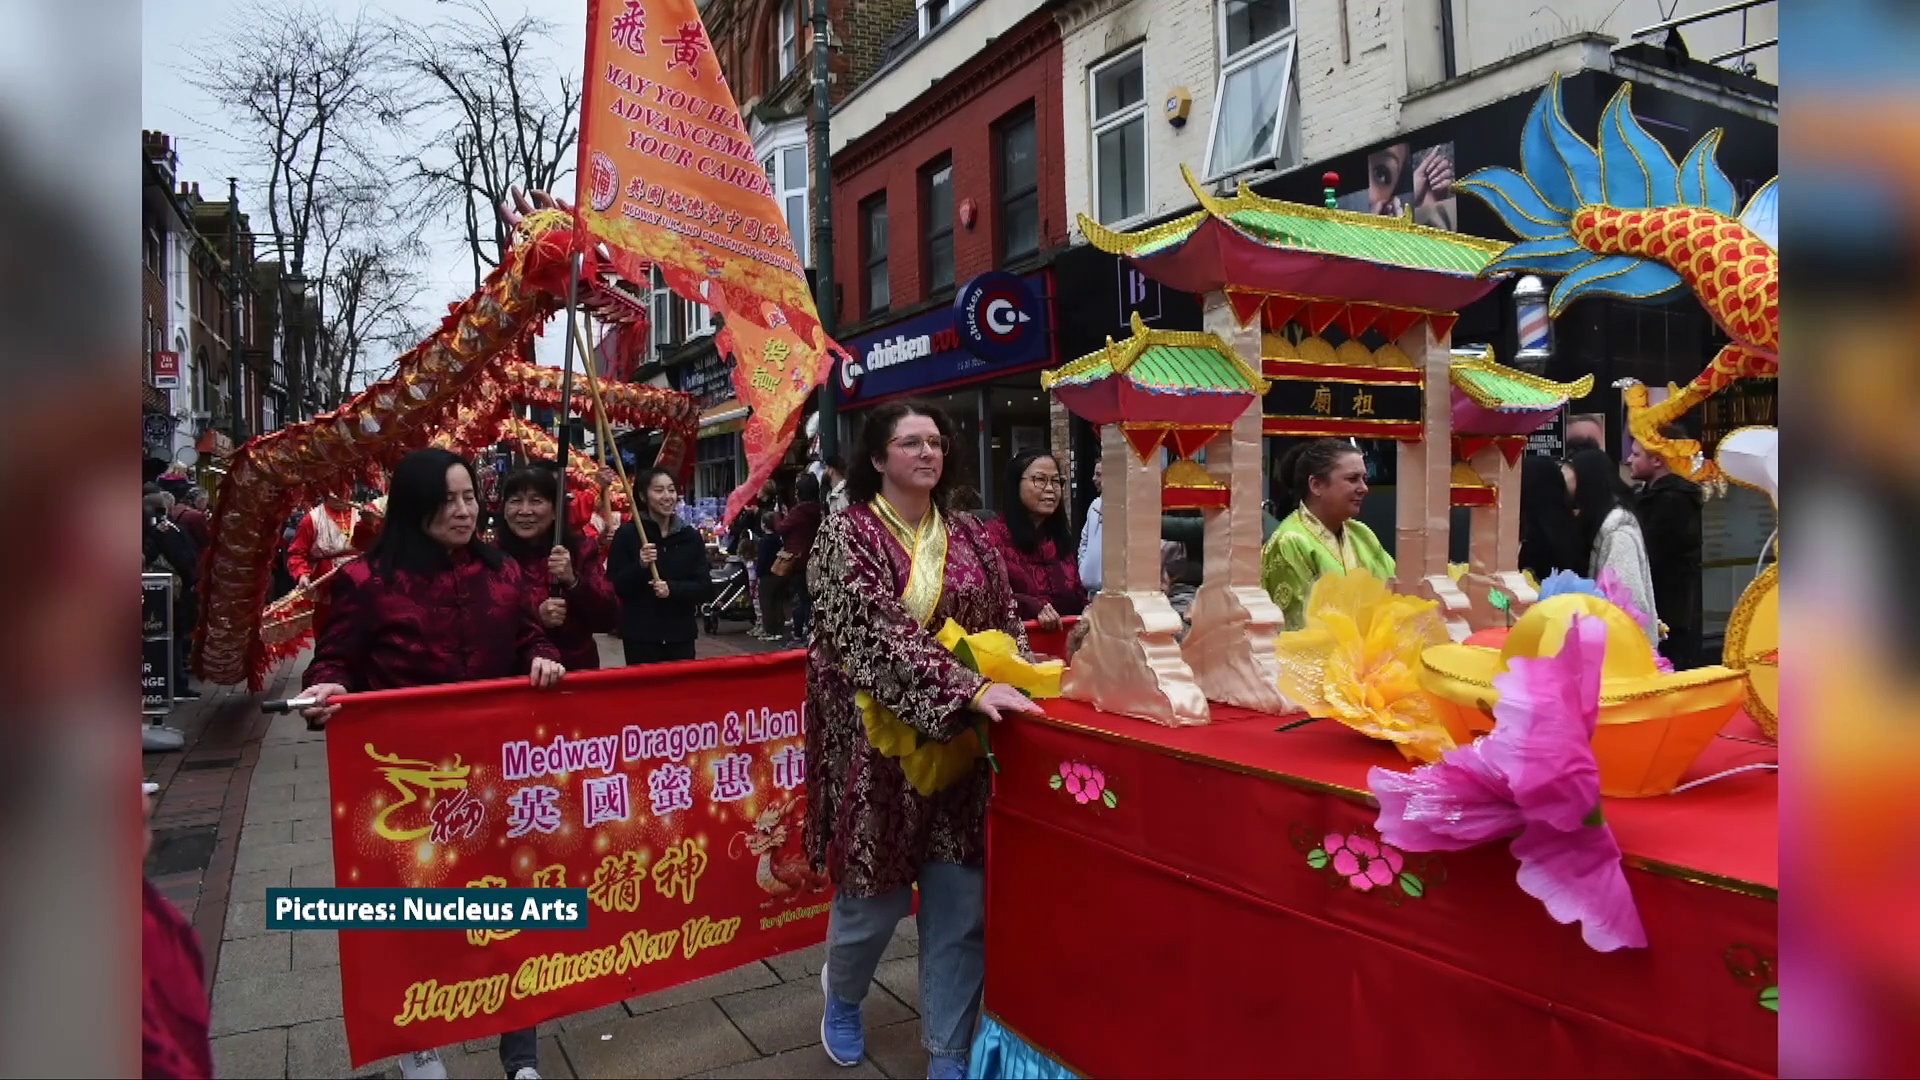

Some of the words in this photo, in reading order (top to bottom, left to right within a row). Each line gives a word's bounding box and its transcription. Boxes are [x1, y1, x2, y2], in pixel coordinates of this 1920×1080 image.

[609, 0, 726, 85] 飛黃
[604, 63, 652, 97] MAY
[654, 82, 706, 116] YOU
[706, 103, 748, 134] HA
[609, 97, 761, 168] ADVANCEME
[626, 127, 694, 168] YOUR
[696, 155, 776, 202] CAREE
[621, 202, 660, 225] MEDWAY
[682, 222, 700, 238] AND
[966, 287, 983, 341] chicken
[866, 335, 931, 371] chicken
[503, 734, 618, 780] Medway
[622, 722, 718, 762] Dragon
[723, 711, 741, 745] &
[746, 707, 798, 744] Lion
[394, 973, 510, 1027] Happy
[511, 945, 616, 1000] Chinese
[615, 929, 679, 975] New
[682, 915, 741, 960] Year
